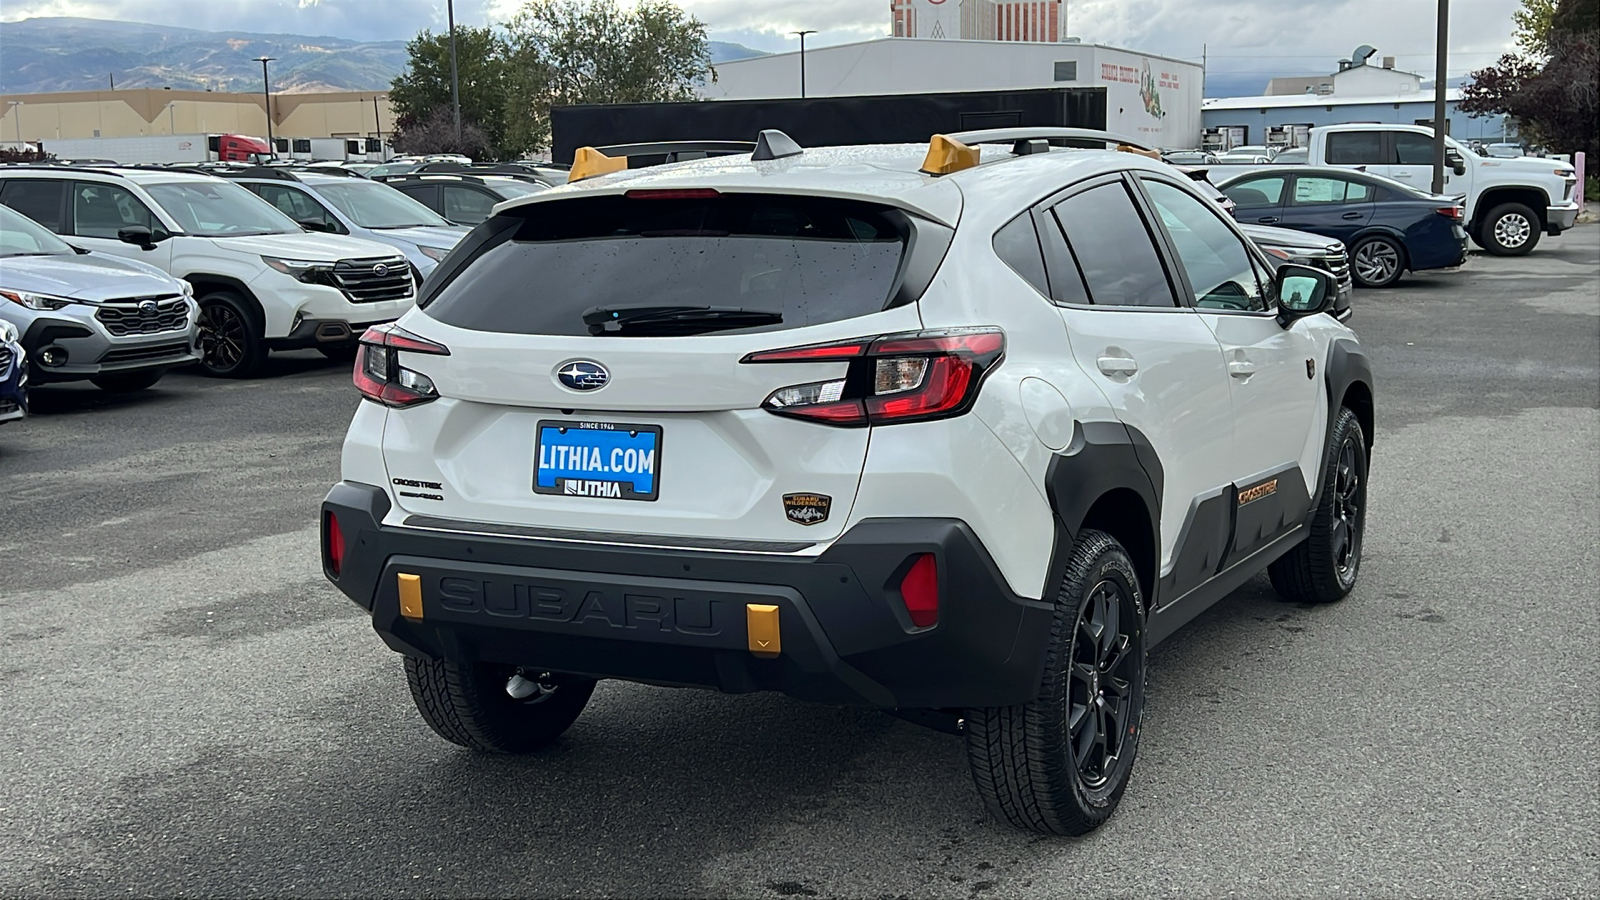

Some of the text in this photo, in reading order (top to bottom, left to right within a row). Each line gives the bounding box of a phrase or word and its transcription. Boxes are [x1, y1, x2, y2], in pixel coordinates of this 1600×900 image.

[579, 422, 599, 430] SINCE
[539, 444, 655, 475] LITHIA.COM
[392, 477, 443, 490] CROSSTREK
[577, 480, 622, 498] LITHIA
[1238, 479, 1278, 505] CROSSTREK
[439, 576, 723, 636] SUBARU
